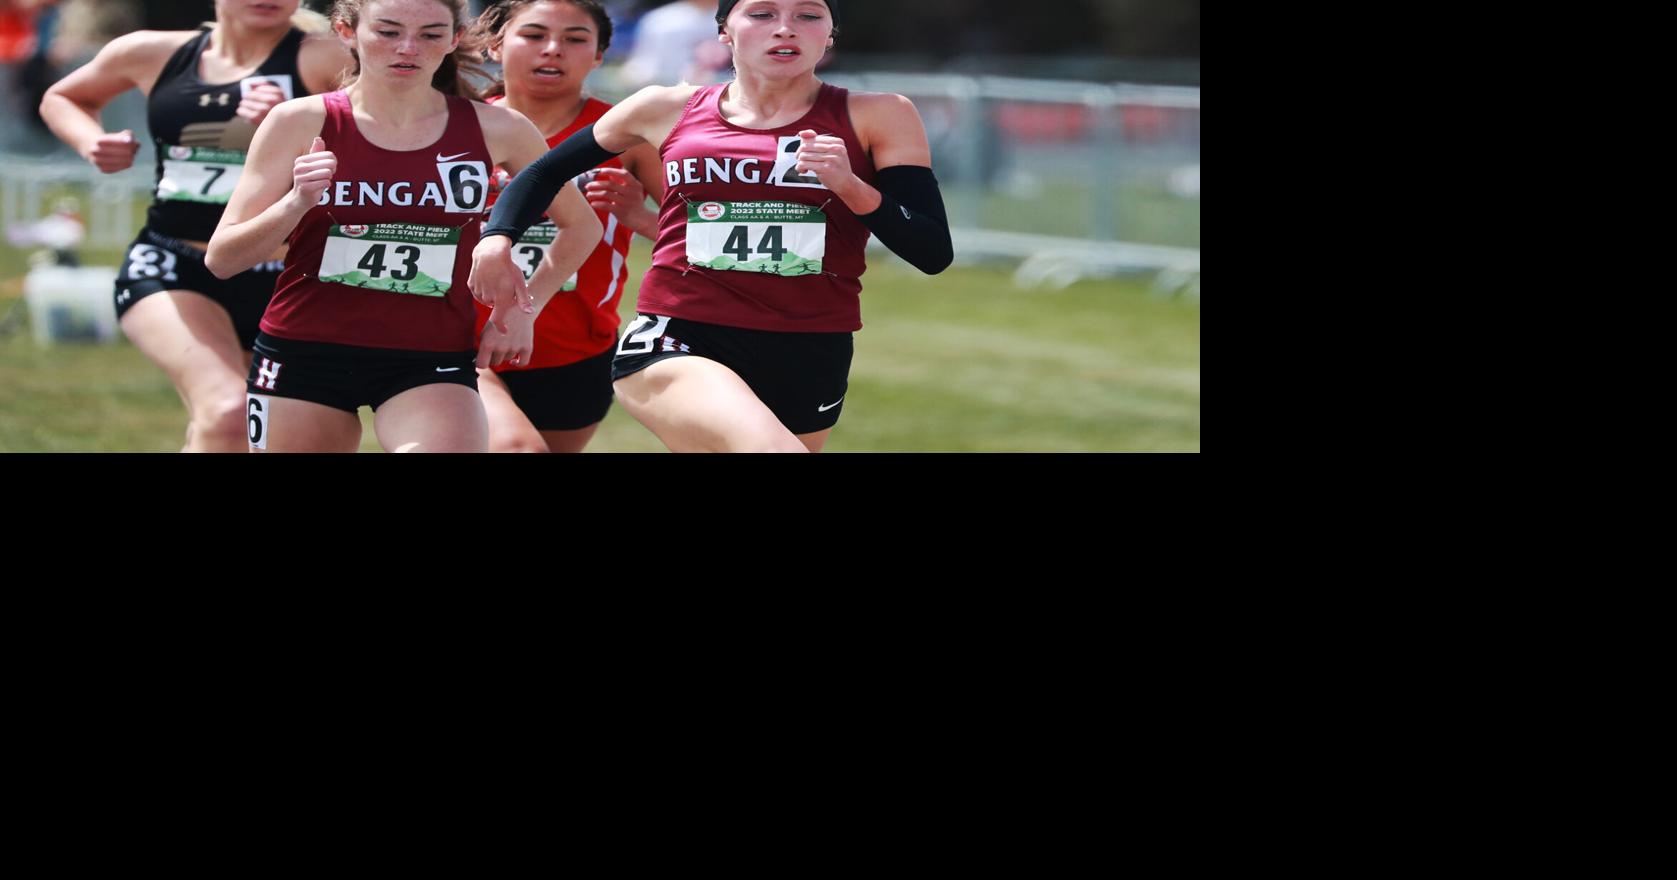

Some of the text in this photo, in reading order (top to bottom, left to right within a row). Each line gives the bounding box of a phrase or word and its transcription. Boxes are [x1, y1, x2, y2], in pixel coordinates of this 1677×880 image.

[201, 166, 227, 195] 7
[448, 164, 483, 210] 6
[357, 243, 421, 281] 43
[722, 225, 788, 262] 44
[621, 313, 659, 352] 2
[255, 357, 283, 390] H
[248, 397, 263, 444] 6
